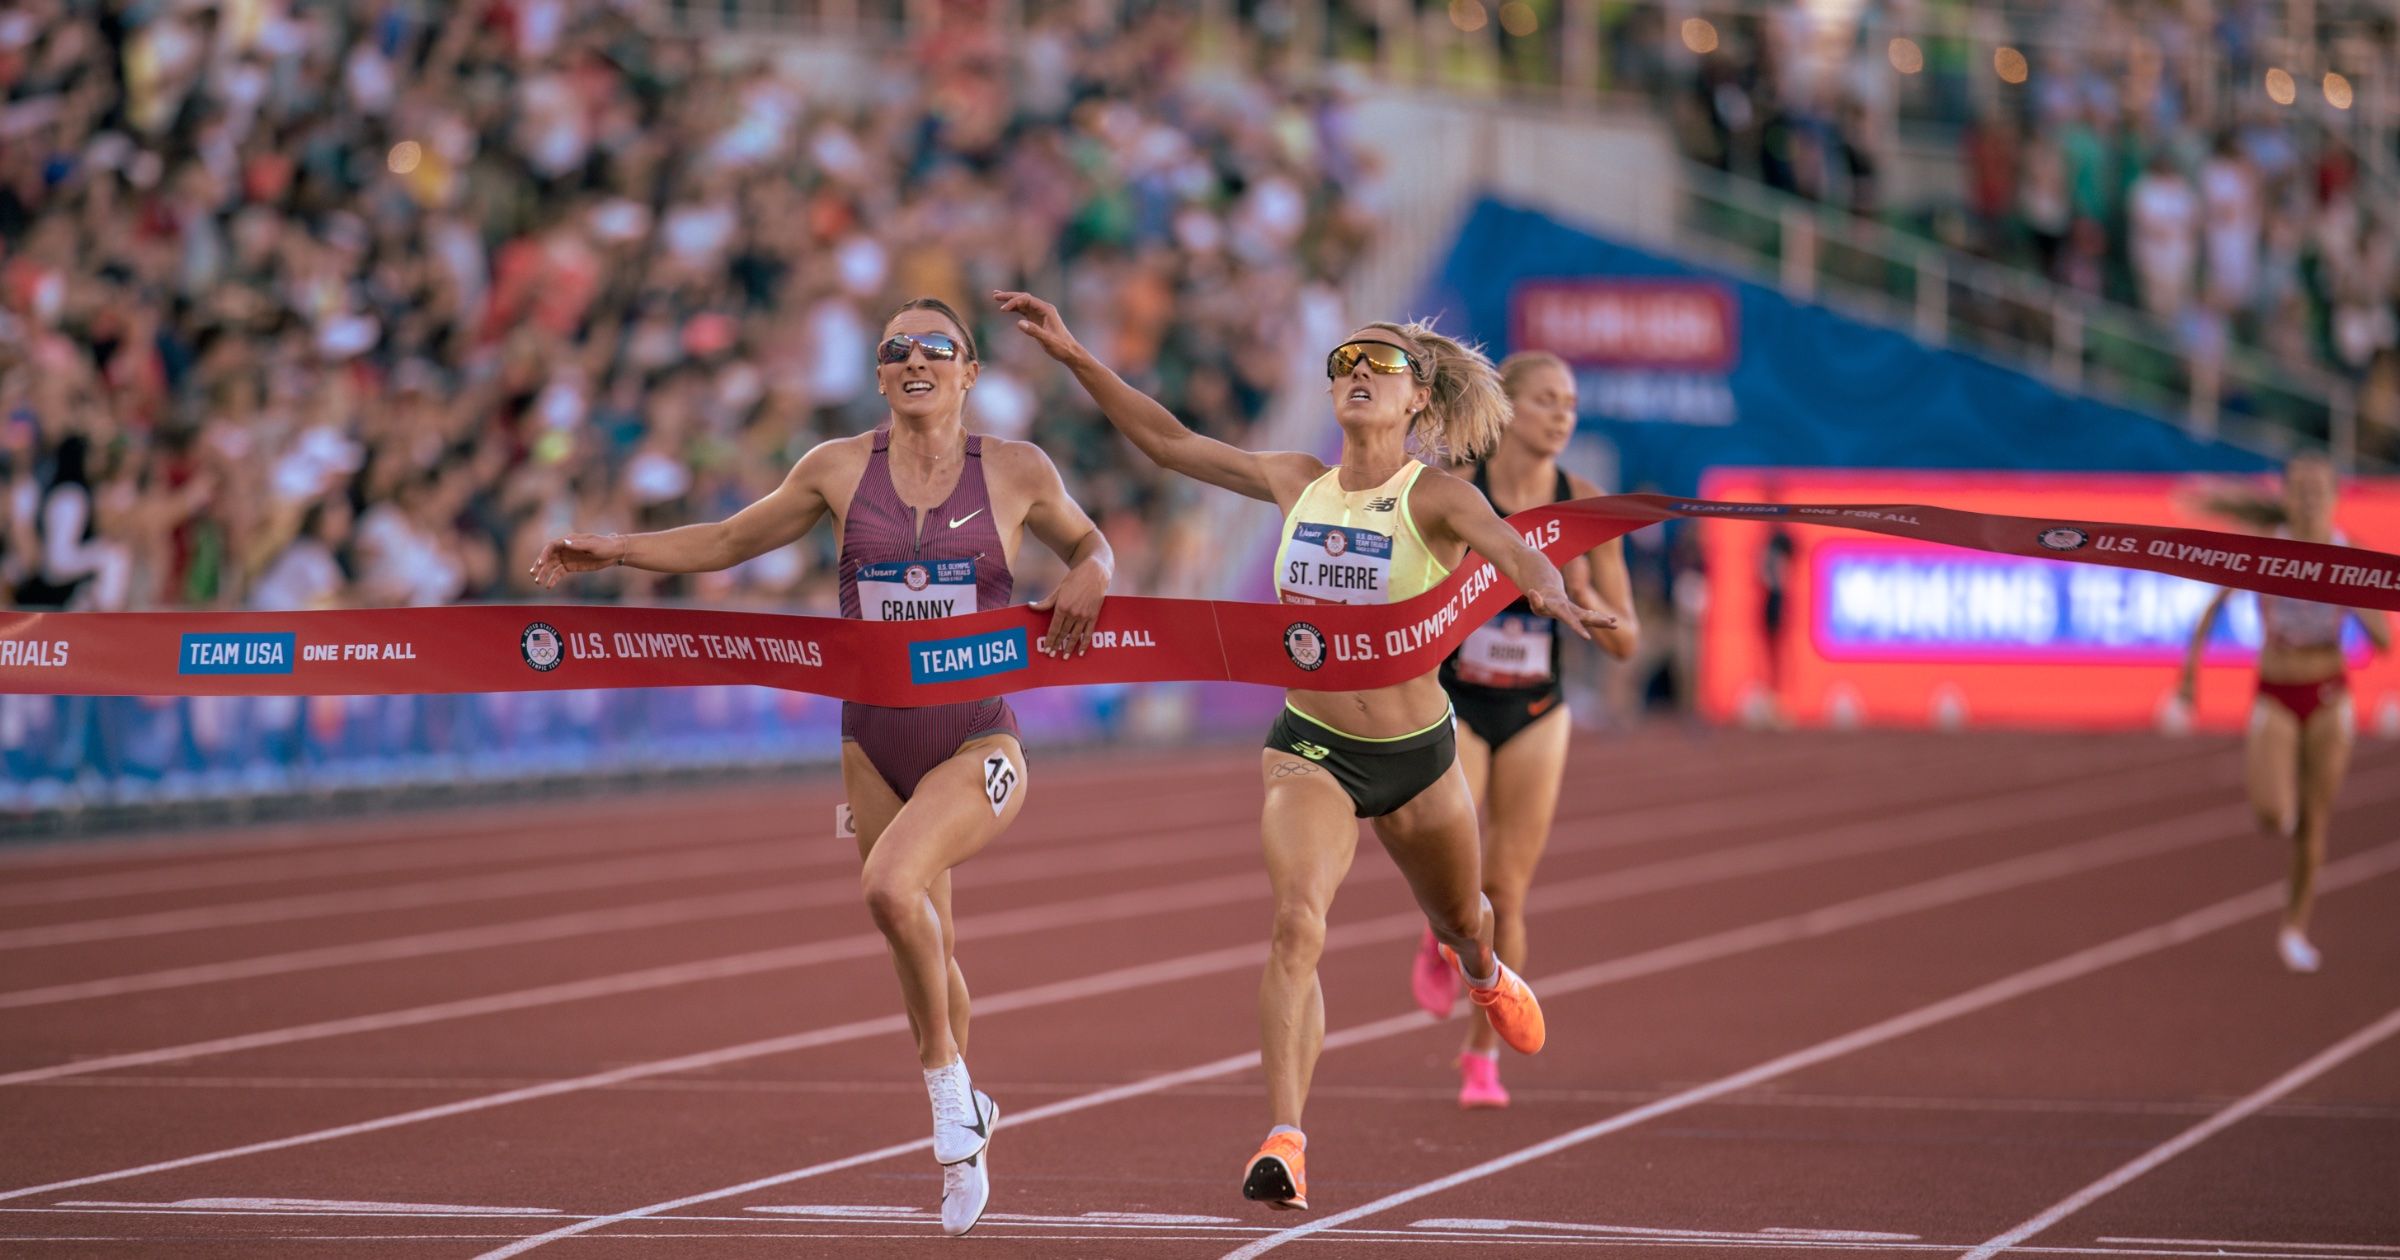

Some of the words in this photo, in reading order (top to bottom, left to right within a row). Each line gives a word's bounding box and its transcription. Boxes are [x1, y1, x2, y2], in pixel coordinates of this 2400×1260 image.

[1842, 509, 1880, 520] FOR
[1883, 512, 1920, 525] ALL
[2095, 535, 2138, 554] U.S.
[2147, 540, 2252, 572] OLYMPIC
[2258, 556, 2323, 582] TEAM
[1289, 561, 1312, 585] ST.
[1318, 564, 1378, 590] PIERRE
[1333, 634, 1380, 661] U.S.
[1385, 595, 1459, 656] OLYMPIC
[1459, 561, 1498, 609] TEAM
[1524, 519, 1561, 552] ALS
[882, 599, 955, 621] CRANNY
[0, 640, 68, 667] RIALS
[190, 642, 239, 665] TEAM
[244, 642, 284, 665] USA
[303, 644, 338, 661] ONE
[343, 644, 379, 660] FOR
[382, 643, 416, 660] ALL
[569, 632, 611, 660] U.S.
[614, 632, 699, 659] OLYMPIC
[698, 634, 757, 660] TEAM
[755, 637, 823, 667] TRIALS
[920, 646, 974, 674] TEAM
[979, 639, 1018, 667] USA
[1080, 630, 1117, 648] OR
[1121, 630, 1156, 647] ALL
[987, 757, 1015, 804] 15
